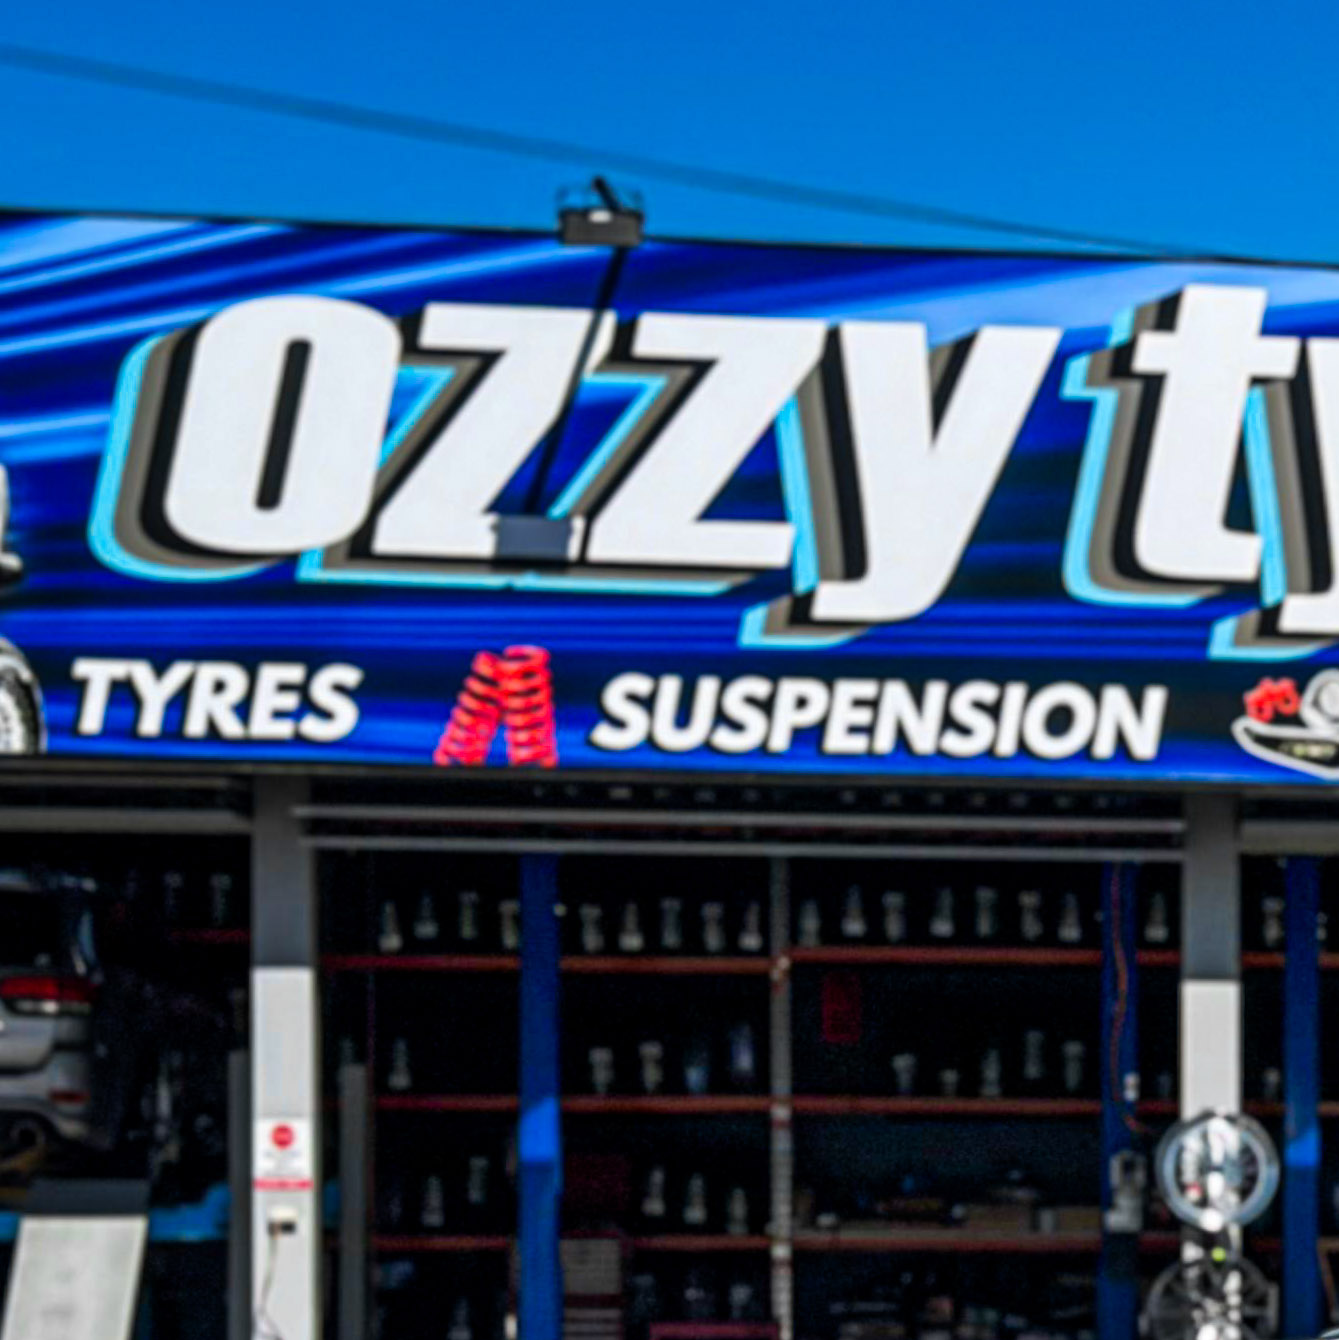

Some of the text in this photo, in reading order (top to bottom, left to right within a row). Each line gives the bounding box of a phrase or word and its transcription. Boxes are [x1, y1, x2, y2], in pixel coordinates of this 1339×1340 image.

[163, 293, 1063, 623] ozzy
[72, 659, 362, 740] TYRES
[591, 673, 1167, 758] SUSPENSION
